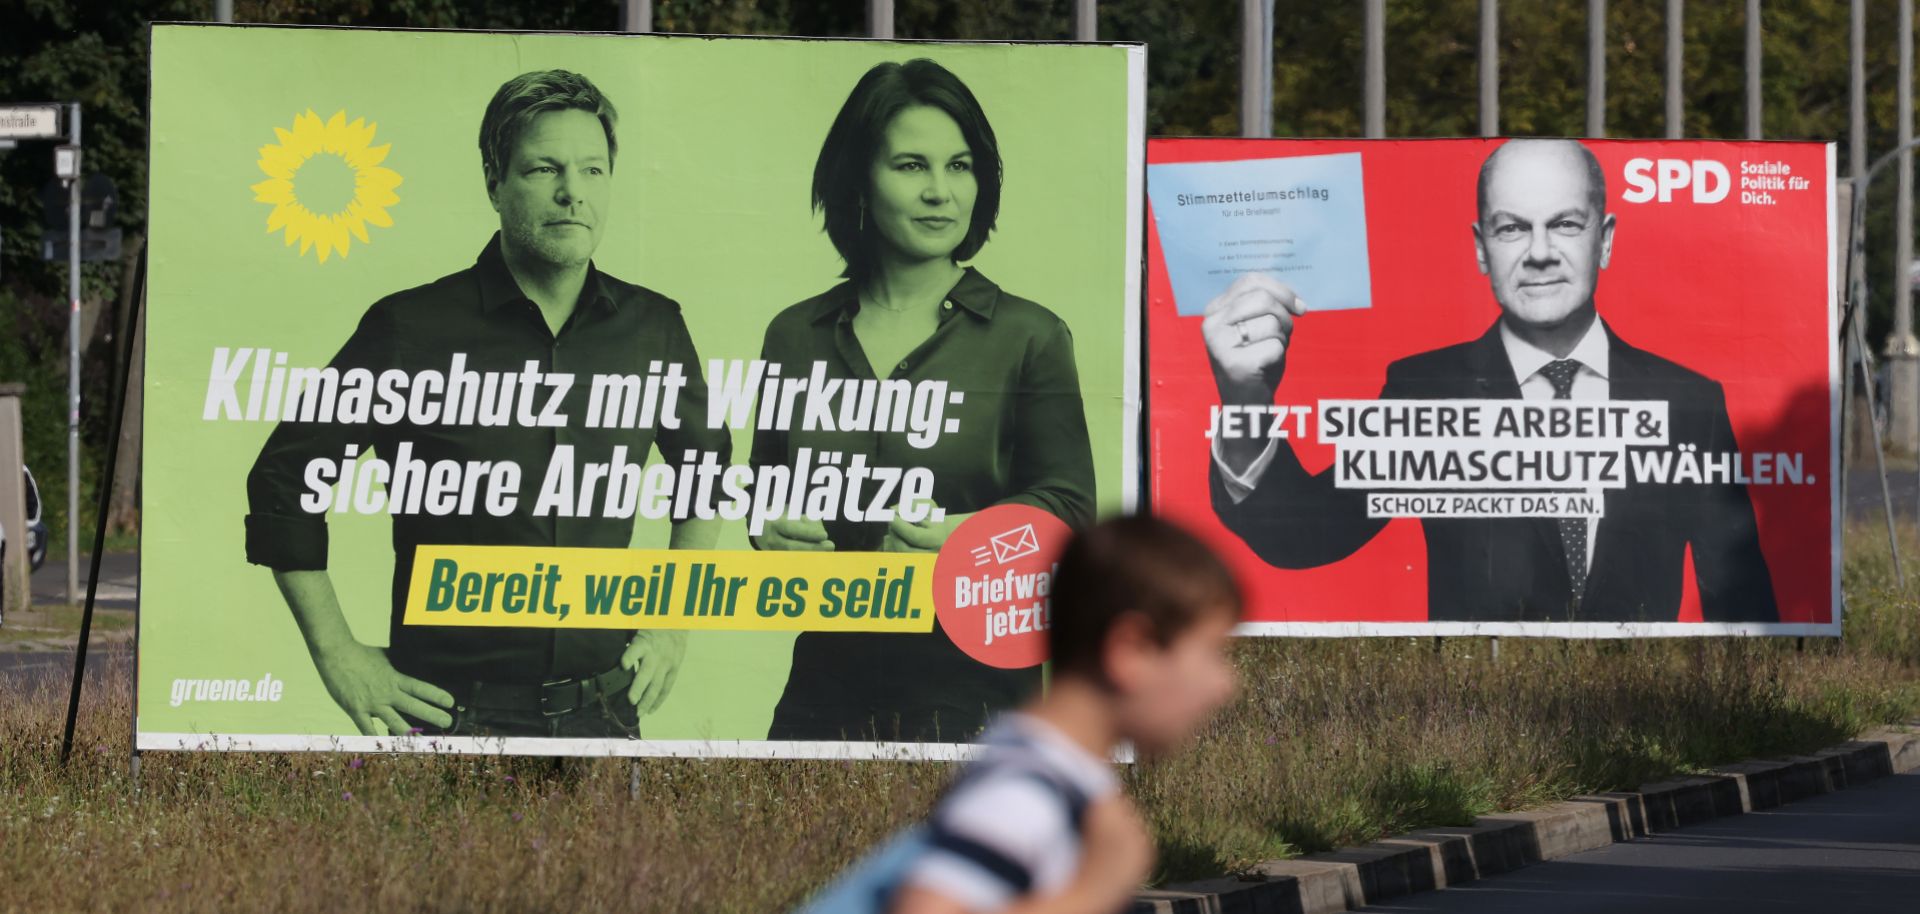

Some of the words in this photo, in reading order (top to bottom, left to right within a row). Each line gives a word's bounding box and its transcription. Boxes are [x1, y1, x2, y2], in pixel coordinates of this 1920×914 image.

[1622, 157, 1731, 204] SPD
[1741, 161, 1790, 175] Soziale
[1741, 176, 1785, 190] Politik
[1789, 176, 1809, 190] für
[1177, 188, 1329, 206] Stimmzettelumschlag
[1741, 192, 1776, 205] Dich.
[202, 346, 577, 428] Klimaschutz
[584, 360, 687, 430] mit
[706, 359, 966, 450] Wirkung:
[1205, 404, 1311, 439] JETZT
[1324, 406, 1482, 439] SICHERE
[1493, 407, 1629, 438] ARBEIT
[1636, 409, 1662, 438] &
[1342, 449, 1619, 482] KLIMASCHUTZ
[1630, 443, 1816, 485] WÄHLEN.
[299, 442, 522, 515] sichere
[532, 443, 947, 536] Arbeitsplätze.
[1371, 495, 1446, 514] SCHOLZ
[1452, 496, 1514, 514] PACKT
[1520, 497, 1560, 514] DAS
[1566, 497, 1601, 515] AN.
[426, 558, 570, 623] Bereit,
[583, 562, 679, 616] weil
[684, 564, 748, 616] Ihr
[755, 578, 806, 618] es
[821, 566, 922, 620] seid.
[955, 562, 1058, 608] Briefwa
[170, 673, 283, 707] gruene.de
